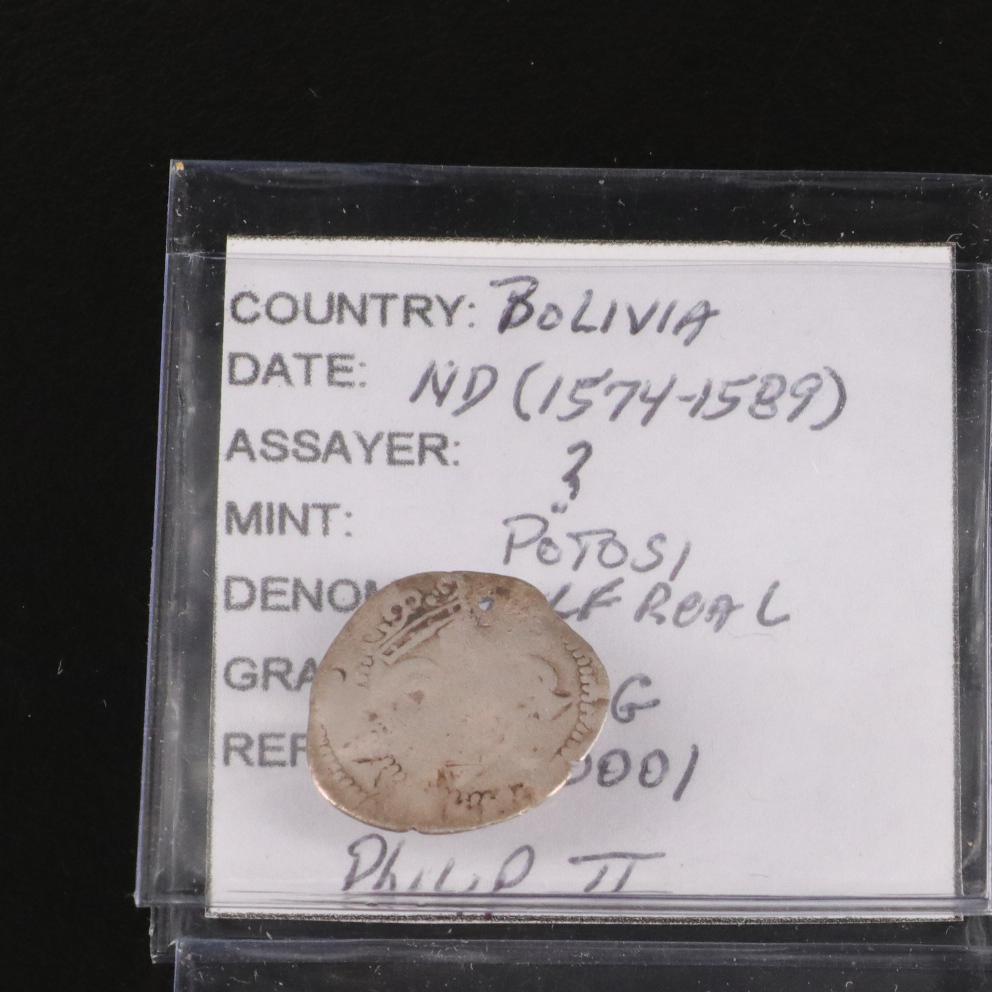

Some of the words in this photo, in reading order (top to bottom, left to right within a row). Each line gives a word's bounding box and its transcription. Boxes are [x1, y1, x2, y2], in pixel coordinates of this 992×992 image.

[229, 290, 476, 328] COUNTRY:
[227, 351, 366, 388] DATE:
[408, 360, 499, 417] ND
[225, 428, 460, 467] ASSAYER:
[561, 440, 593, 501] ?
[225, 500, 352, 537] MINT:
[222, 654, 320, 694] GRA
